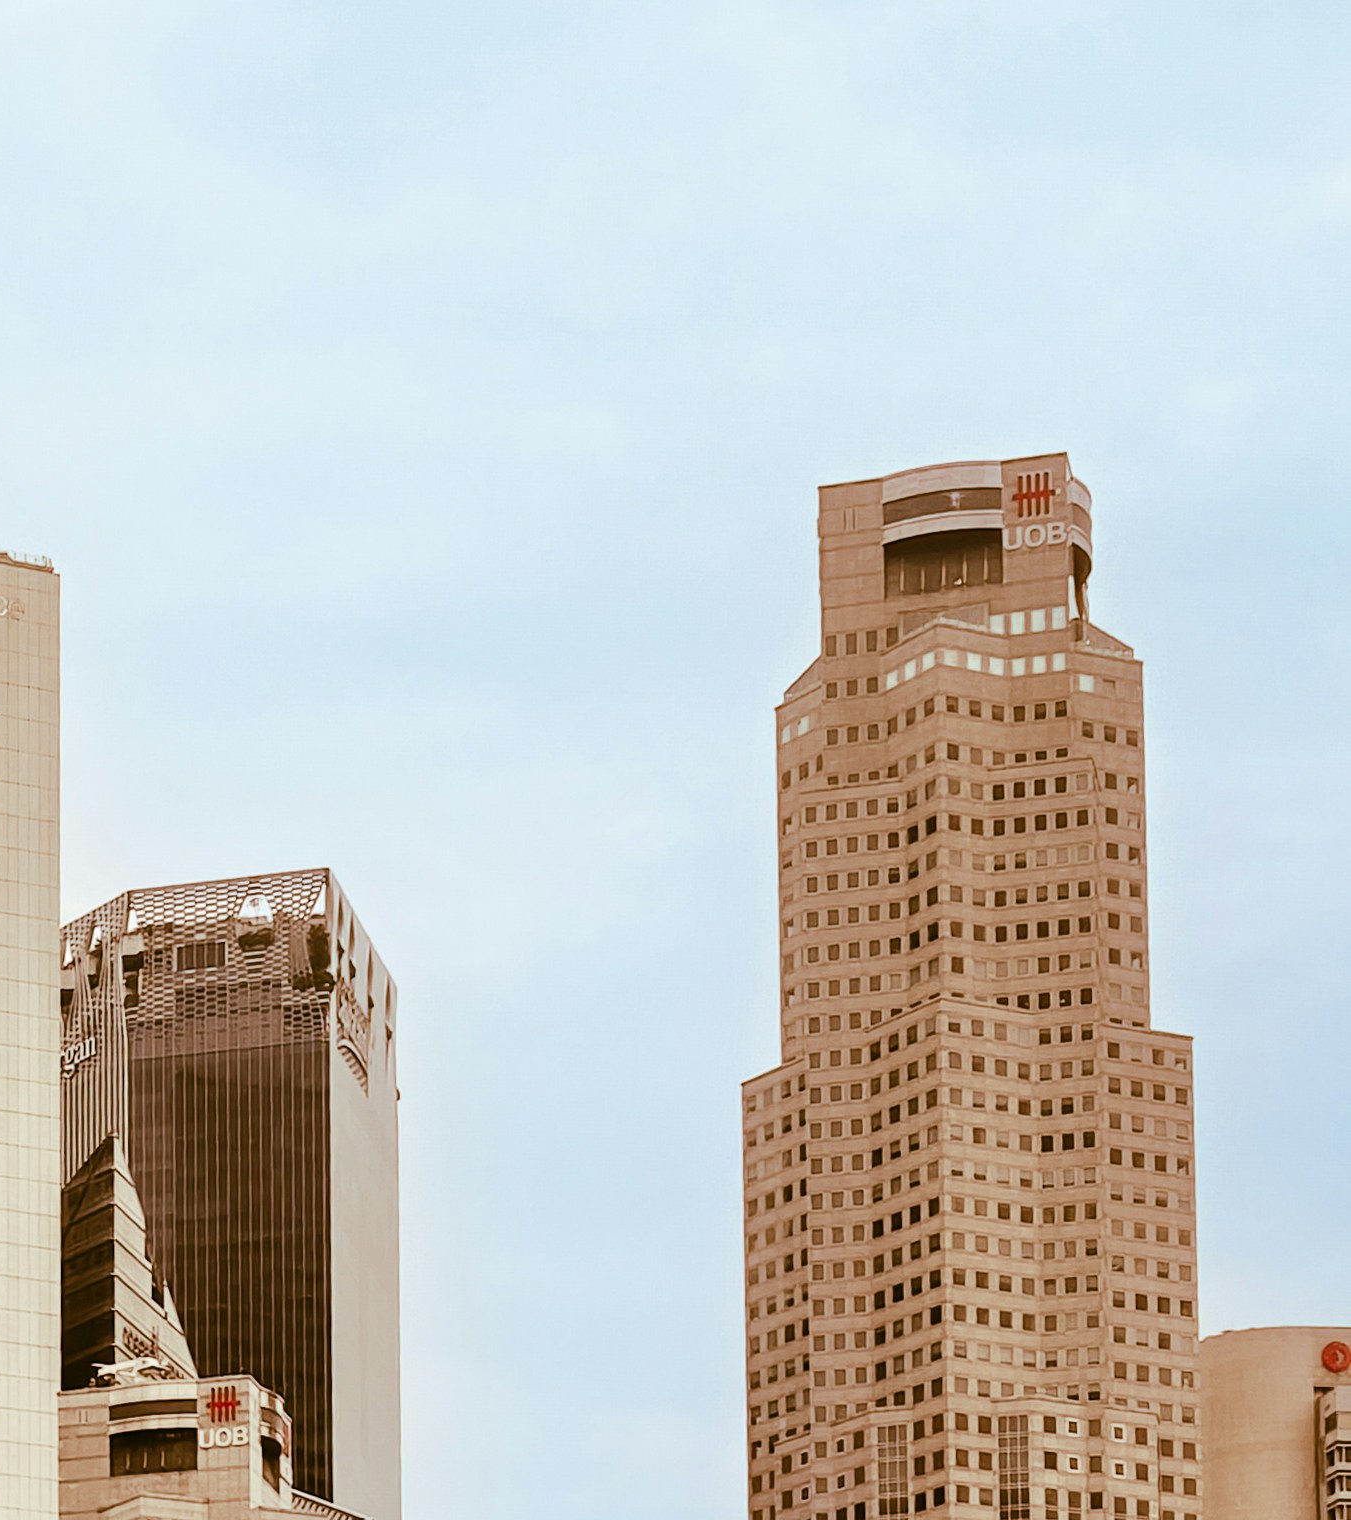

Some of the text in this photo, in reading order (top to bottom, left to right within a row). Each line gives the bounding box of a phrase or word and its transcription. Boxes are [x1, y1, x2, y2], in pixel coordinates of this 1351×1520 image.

[1002, 521, 1067, 551] UOB
[60, 1037, 97, 1079] gan
[198, 1425, 249, 1449] UOB
